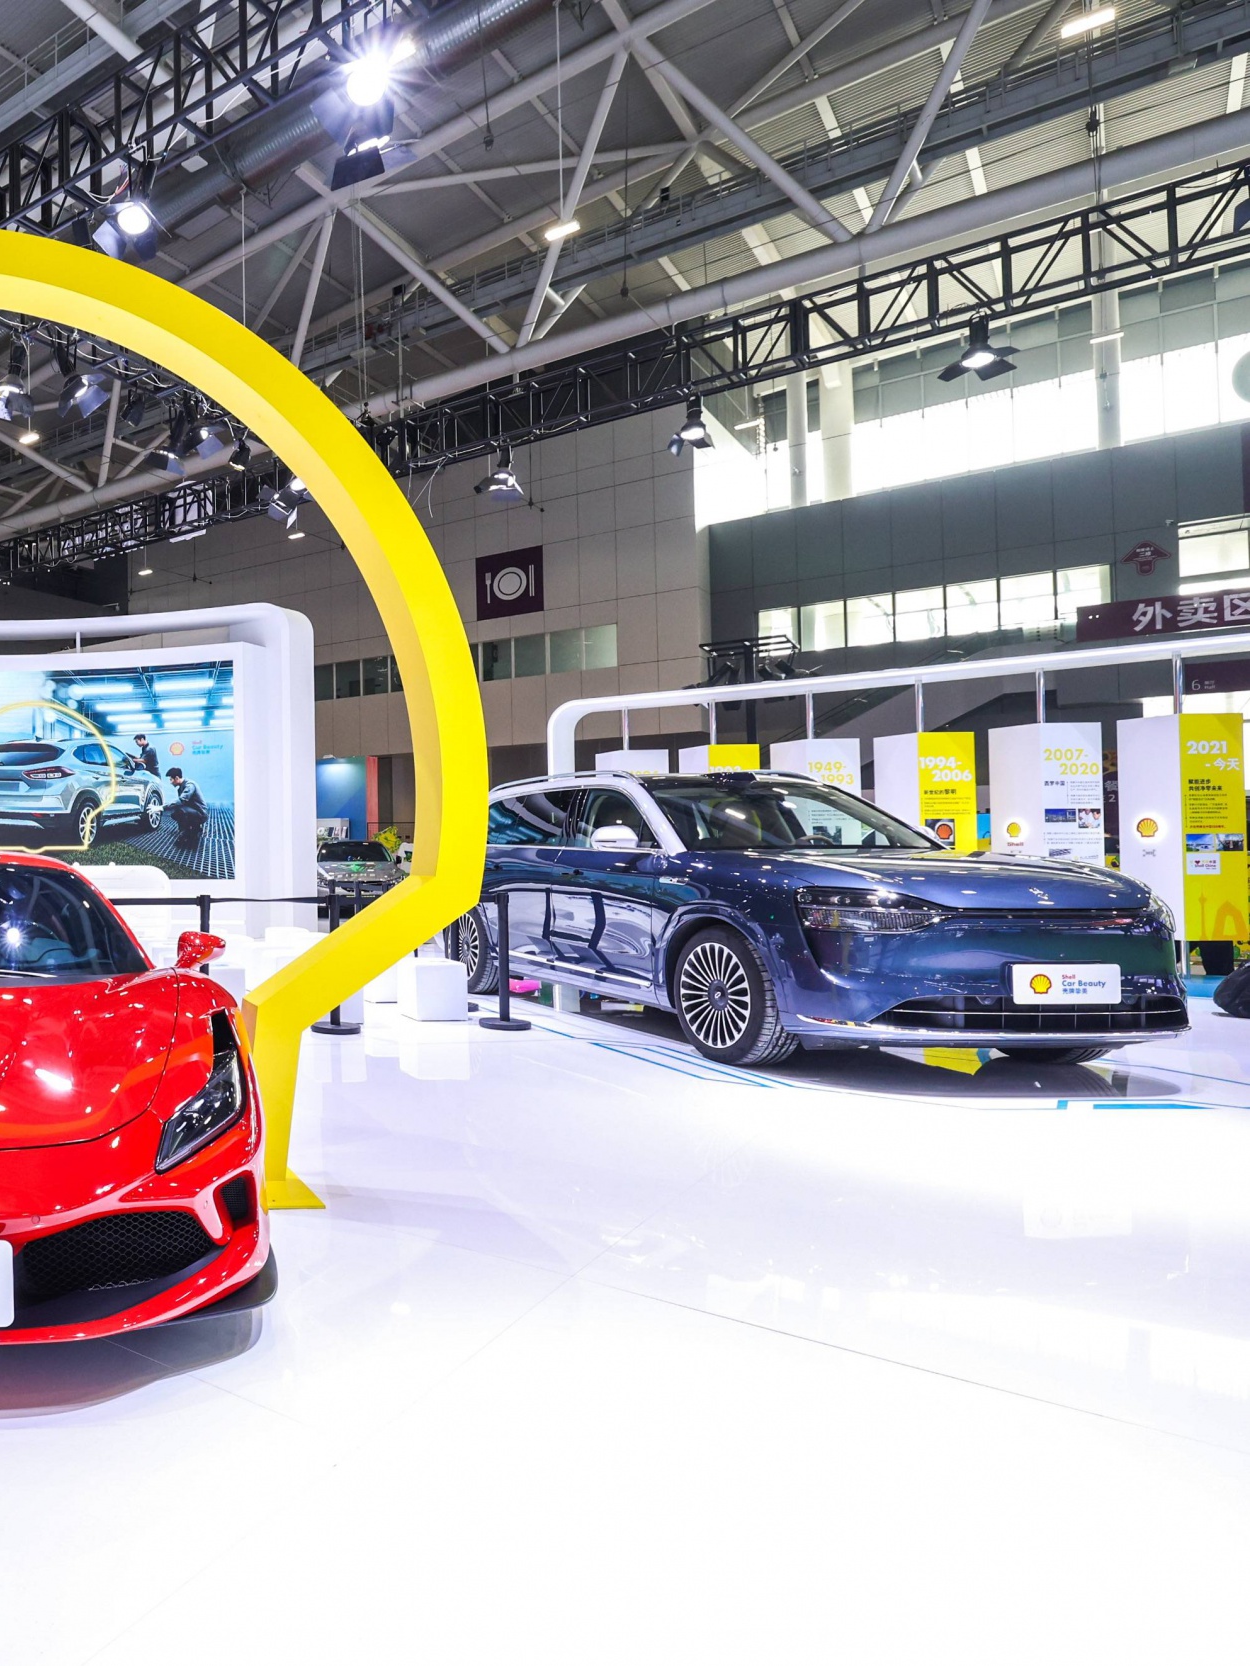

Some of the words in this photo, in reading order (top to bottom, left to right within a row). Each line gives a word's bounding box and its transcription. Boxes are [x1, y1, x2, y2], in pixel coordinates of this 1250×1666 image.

[1132, 592, 1250, 632] 外卖区
[1191, 679, 1201, 691] 6
[1186, 740, 1228, 755] 2021
[1043, 748, 1089, 761] 2007-
[807, 761, 846, 773] 1949-
[919, 756, 962, 769] 1994-
[1059, 763, 1100, 775] 2020
[821, 774, 855, 785] 1993
[931, 769, 972, 782] 2006
[1077, 980, 1107, 988] Beauty
